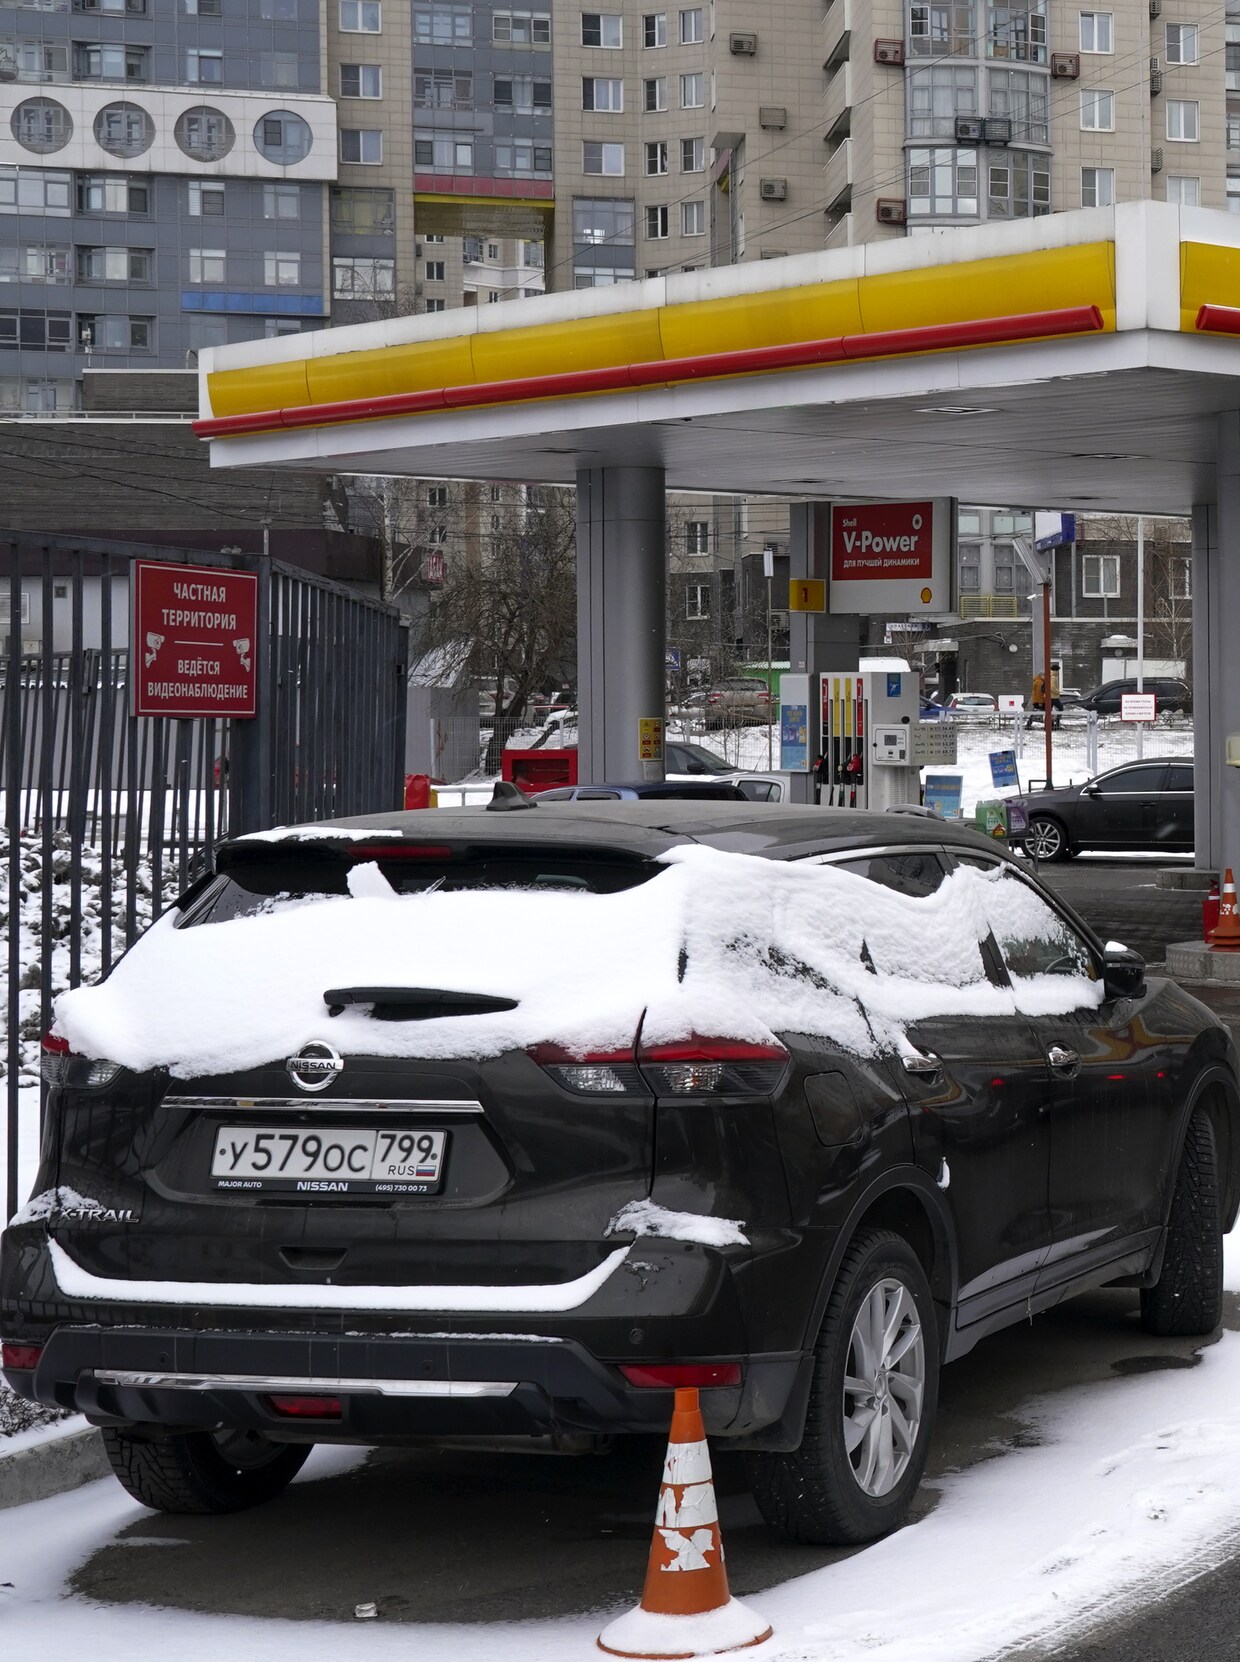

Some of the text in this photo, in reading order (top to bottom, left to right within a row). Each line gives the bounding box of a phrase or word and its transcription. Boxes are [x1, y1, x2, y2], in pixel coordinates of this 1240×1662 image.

[842, 518, 857, 528] Shell
[843, 530, 919, 553] V-Power
[843, 557, 920, 568] ДЛЯ ЛУЧШЕЙ ДИНАМИКИ
[173, 582, 226, 603] ЧАСТНАЯ
[802, 587, 808, 603] 1
[162, 608, 237, 630] ТЕРРИТОРИЯ
[177, 657, 220, 677] ВЕДЁТСЯ
[147, 682, 248, 701] ВИДЕОНАБЛЮДЕНИЕ
[290, 1061, 336, 1071] NISSAN
[379, 1133, 434, 1164] 799
[388, 1164, 415, 1176] RUS
[218, 1180, 242, 1188] MAJOR
[296, 1181, 348, 1192] NISSAN
[375, 1184, 393, 1192] (495)
[60, 1208, 140, 1223] X-TRAIL
